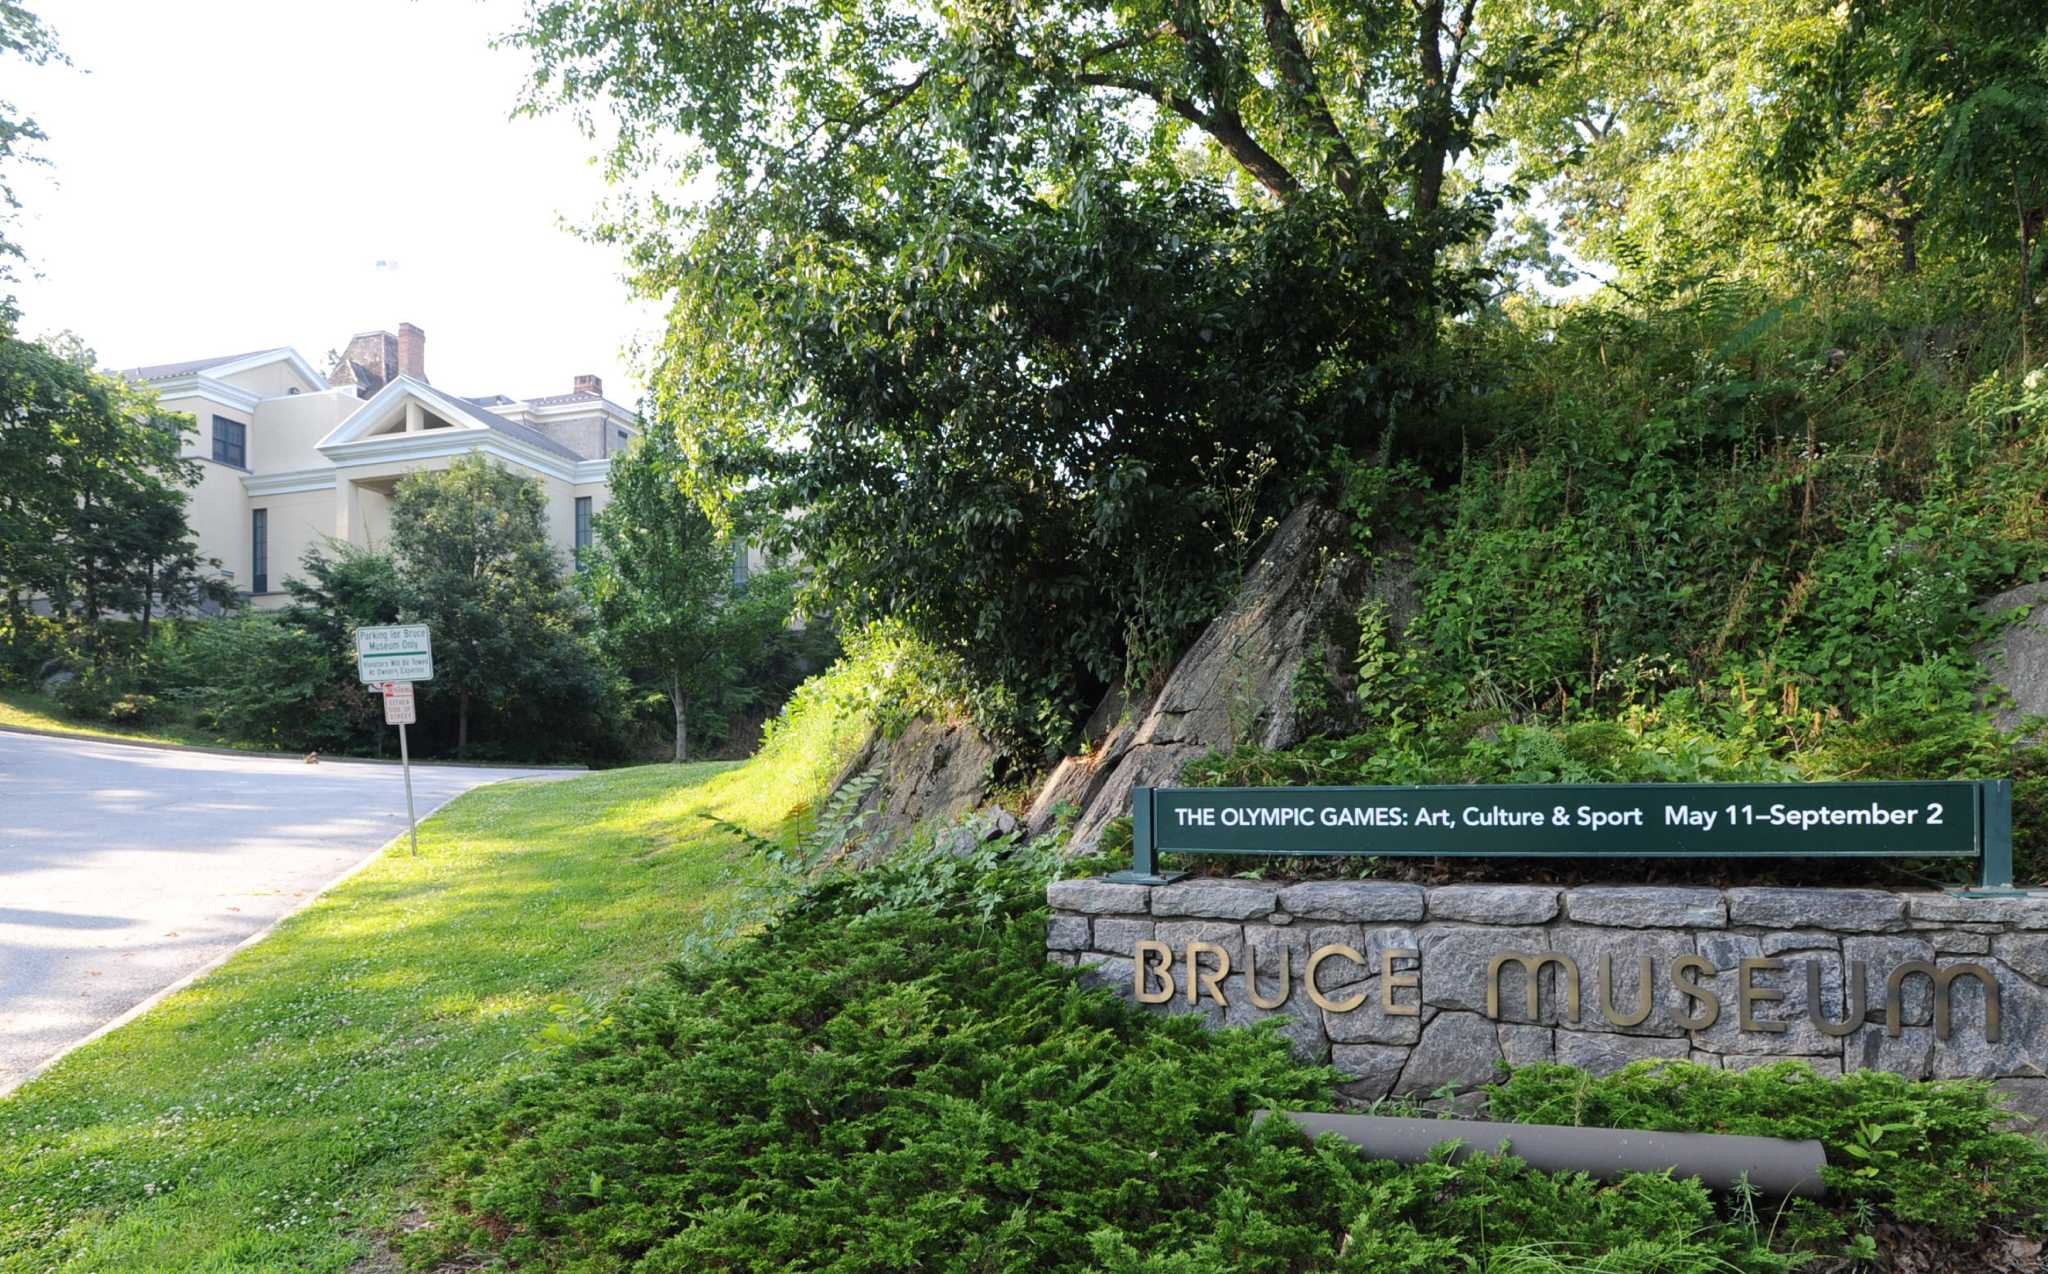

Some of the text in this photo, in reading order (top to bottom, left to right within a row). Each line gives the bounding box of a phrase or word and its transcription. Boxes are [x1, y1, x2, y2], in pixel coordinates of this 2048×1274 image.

[360, 630, 388, 640] Parking
[403, 628, 426, 639] Bruce
[369, 640, 418, 651] Museum Only
[1174, 807, 1216, 827] THE
[1220, 806, 1316, 827] OLYMPIC
[1319, 806, 1409, 827] GAMES:
[1413, 806, 1457, 829] Art,
[1461, 805, 1546, 827] Culture
[1551, 805, 1572, 827] &
[1576, 805, 1644, 832] Sport
[1663, 805, 1718, 832] May
[1925, 802, 1944, 826] 2
[1134, 940, 2001, 1043] BRUCE MUSEUM
